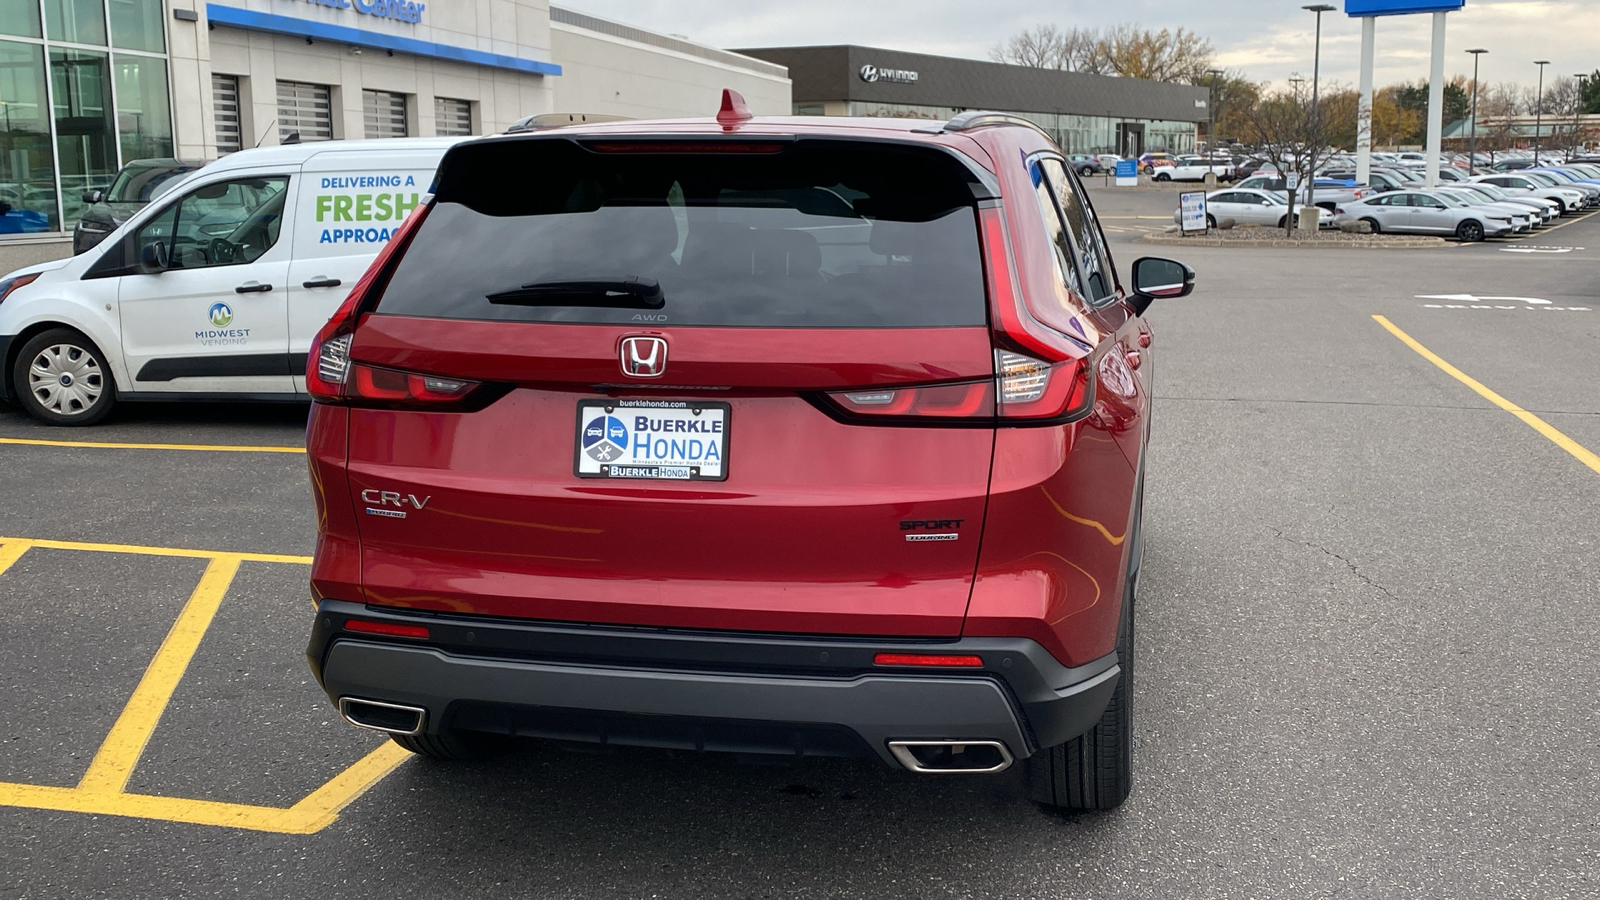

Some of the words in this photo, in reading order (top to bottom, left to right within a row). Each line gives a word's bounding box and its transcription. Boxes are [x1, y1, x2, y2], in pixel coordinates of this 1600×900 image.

[321, 175, 401, 189] DELIVERING
[404, 175, 415, 187] A
[316, 193, 419, 222] FRESH
[631, 314, 668, 322] AWD
[195, 328, 250, 339] MIDWEST
[201, 338, 247, 347] VENDING
[619, 400, 687, 408] buerklehonda.com
[634, 416, 722, 433] BUERKLE
[632, 433, 720, 461] HONDA
[361, 488, 432, 510] CR-V
[899, 518, 965, 530] SPORT
